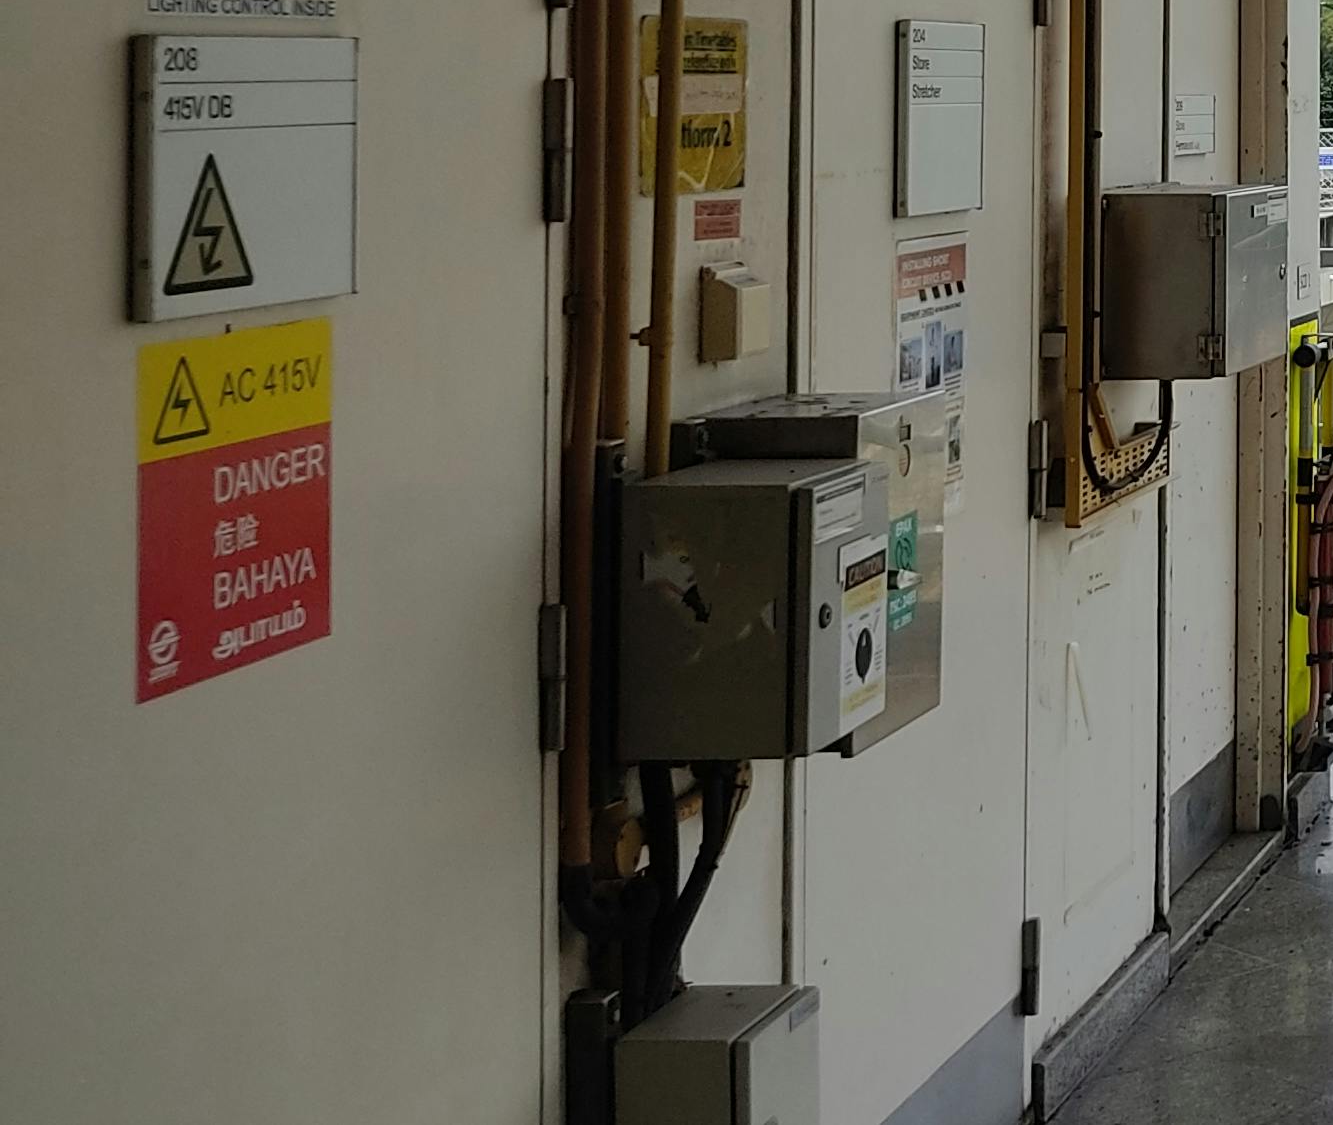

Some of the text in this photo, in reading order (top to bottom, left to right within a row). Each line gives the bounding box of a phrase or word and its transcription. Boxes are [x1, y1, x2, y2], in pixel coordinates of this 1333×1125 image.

[293, 0, 336, 17] INSIDE
[913, 28, 926, 43] 204
[163, 47, 199, 72] 208
[912, 56, 931, 70] Store
[912, 83, 942, 100] Stretcher
[163, 95, 205, 121] 415V
[722, 119, 732, 147] 2
[218, 354, 323, 408] AC 415V
[212, 442, 326, 505] DANGER
[213, 514, 260, 560] 危险
[212, 547, 318, 611] BAHAYA
